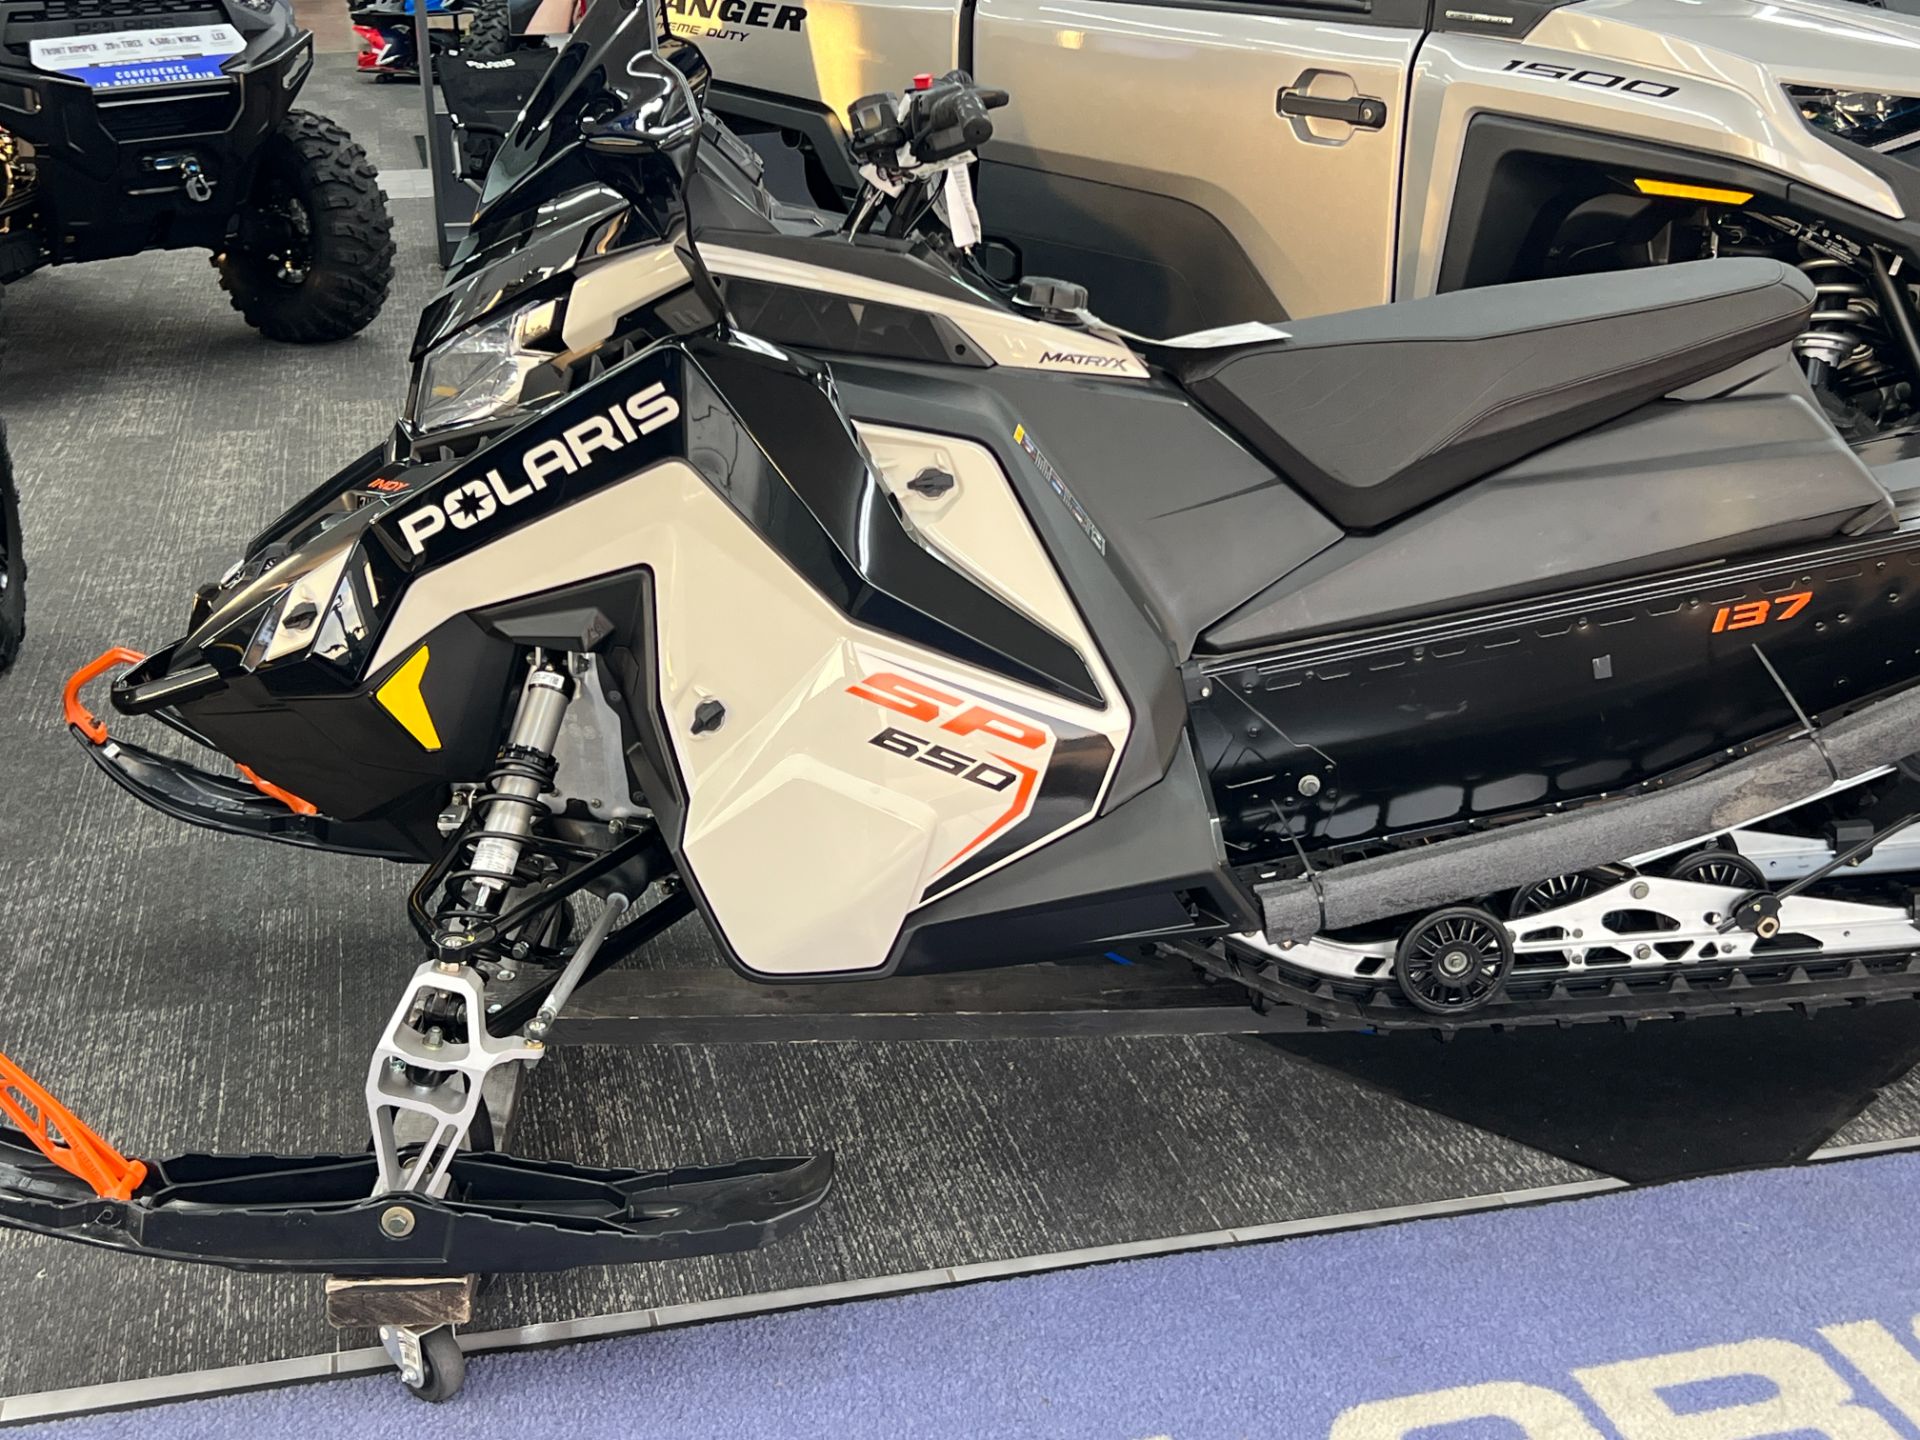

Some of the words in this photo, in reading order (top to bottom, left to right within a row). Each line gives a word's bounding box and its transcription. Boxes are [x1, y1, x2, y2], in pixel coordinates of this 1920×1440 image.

[706, 28, 750, 42] DUTY
[115, 65, 190, 80] CONFIDENCE
[1502, 59, 1680, 98] 1500
[1039, 351, 1128, 372] MATRYX
[367, 478, 410, 492] INDY
[398, 382, 680, 555] POLARIS
[1712, 591, 1813, 633] 137
[845, 672, 1046, 749] SP
[868, 726, 1017, 792] 650
